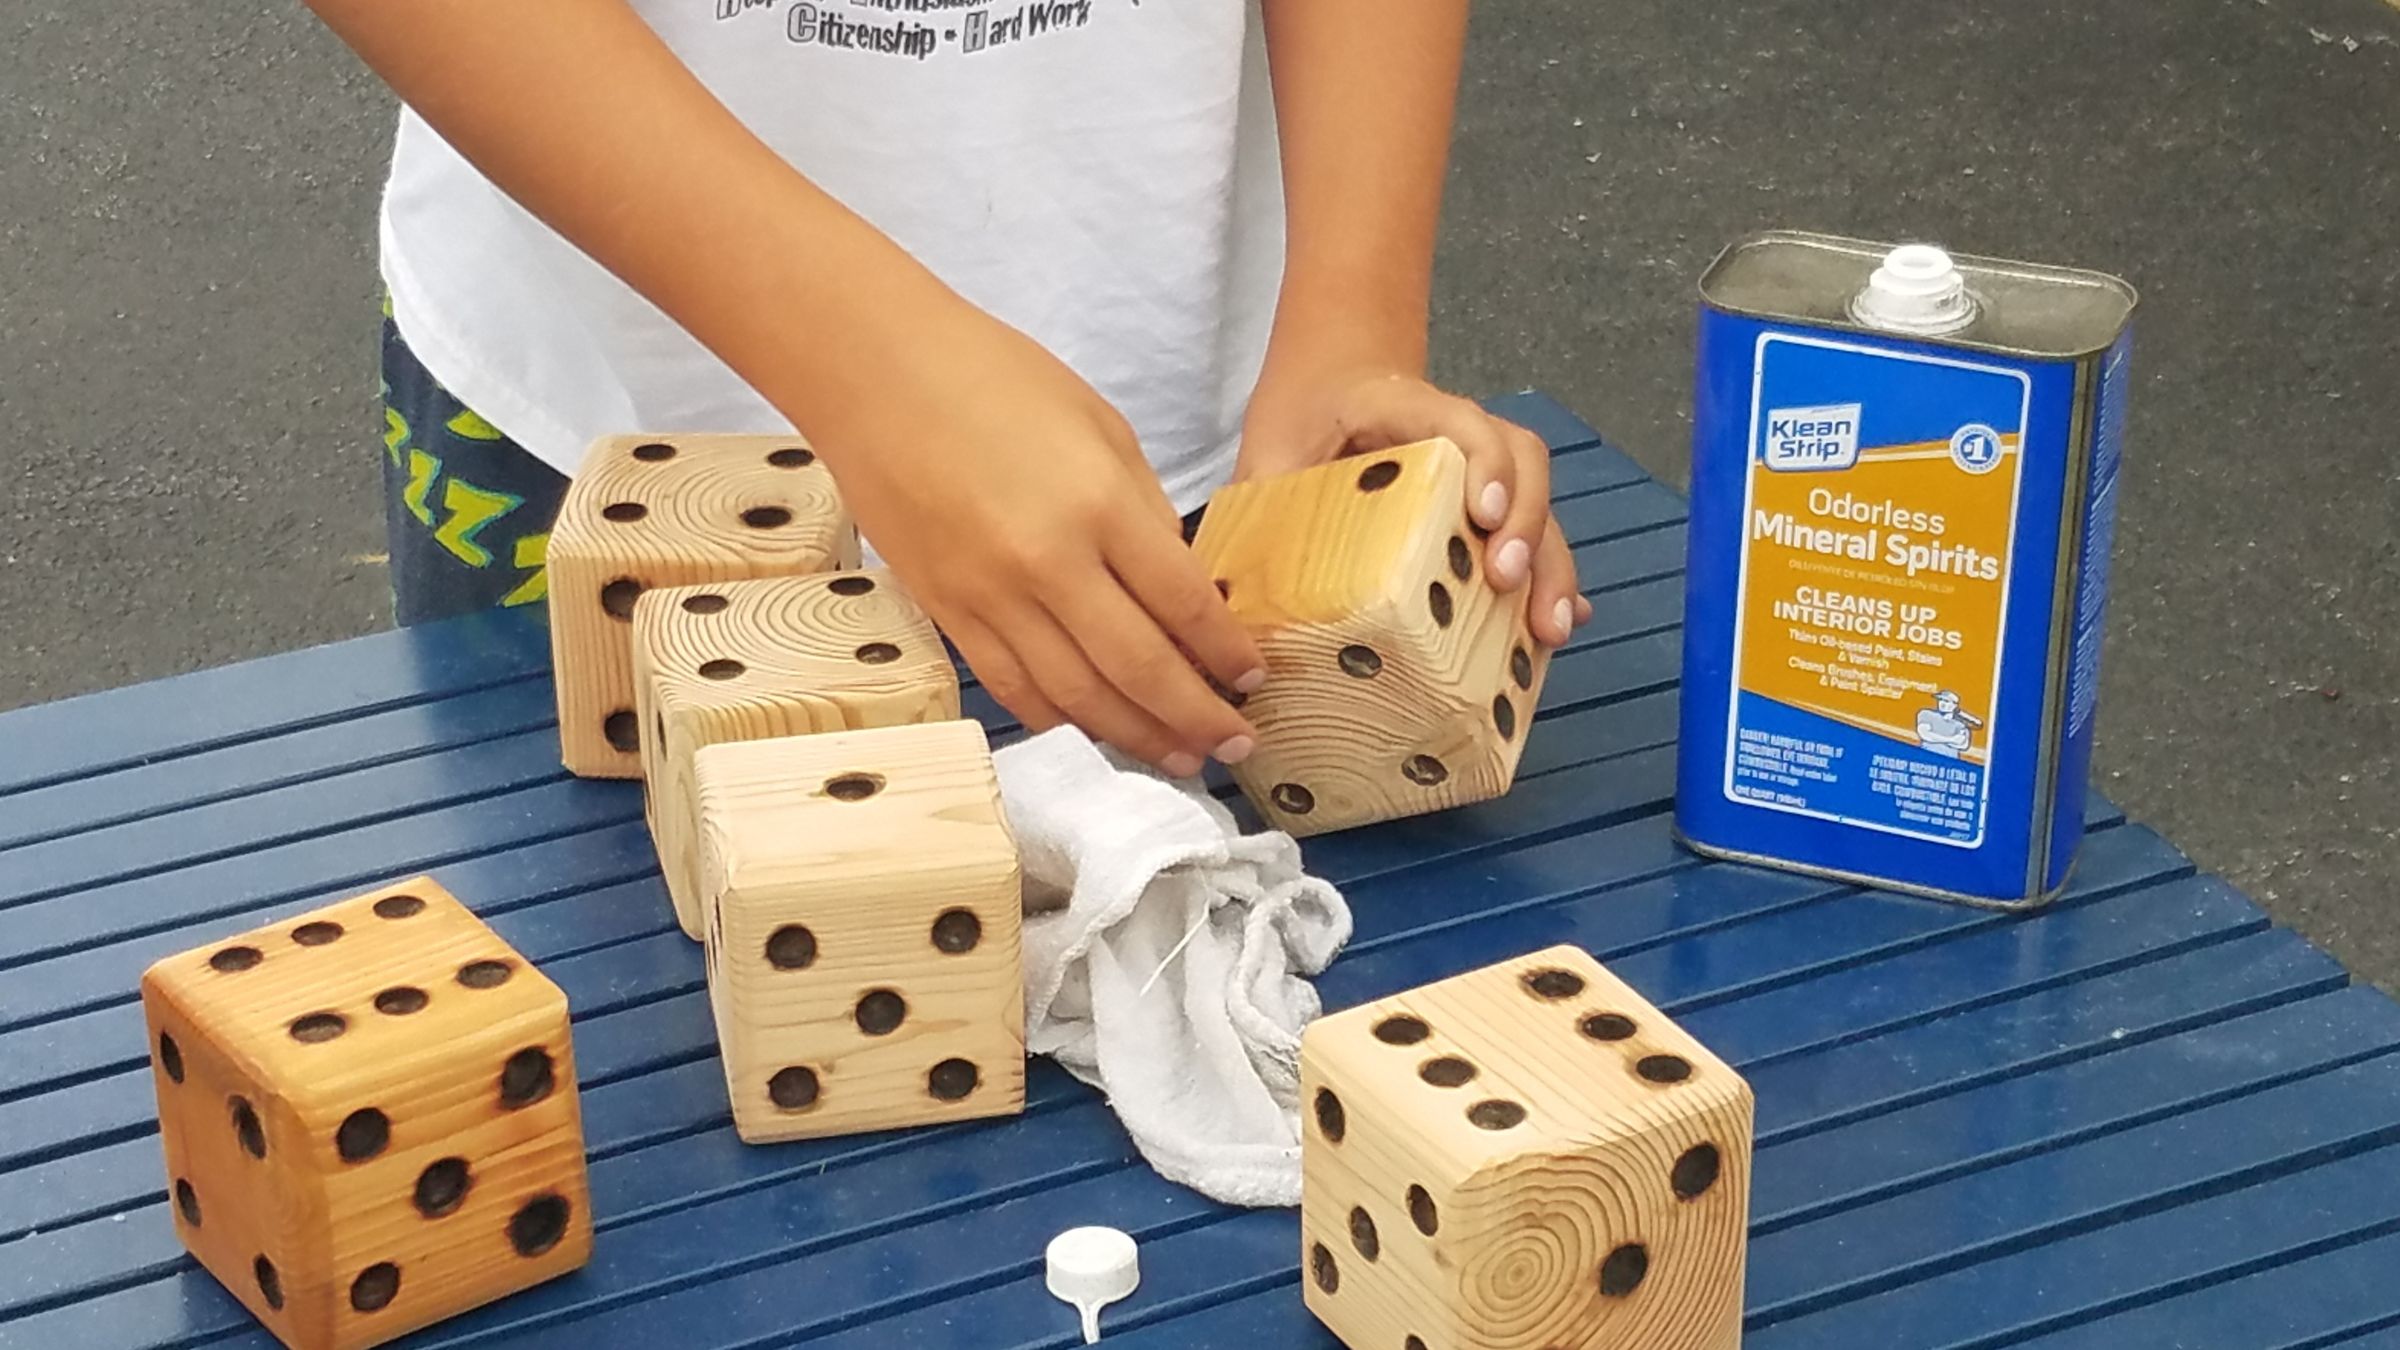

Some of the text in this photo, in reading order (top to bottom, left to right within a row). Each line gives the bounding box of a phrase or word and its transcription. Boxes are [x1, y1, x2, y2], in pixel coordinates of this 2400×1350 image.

[787, 2, 936, 60] Citizenship
[962, 6, 1024, 53] Hard
[1028, 0, 1092, 36] Work
[1771, 419, 1852, 438] Klean
[1778, 438, 1840, 461] Strip
[1808, 487, 1946, 535] Odorless
[1753, 509, 2000, 581] Mineral Spirits
[1773, 600, 1964, 650] INTERIOR JOBS
[1795, 585, 1938, 626] CLEANS UP
[1849, 652, 1891, 670] Varnish
